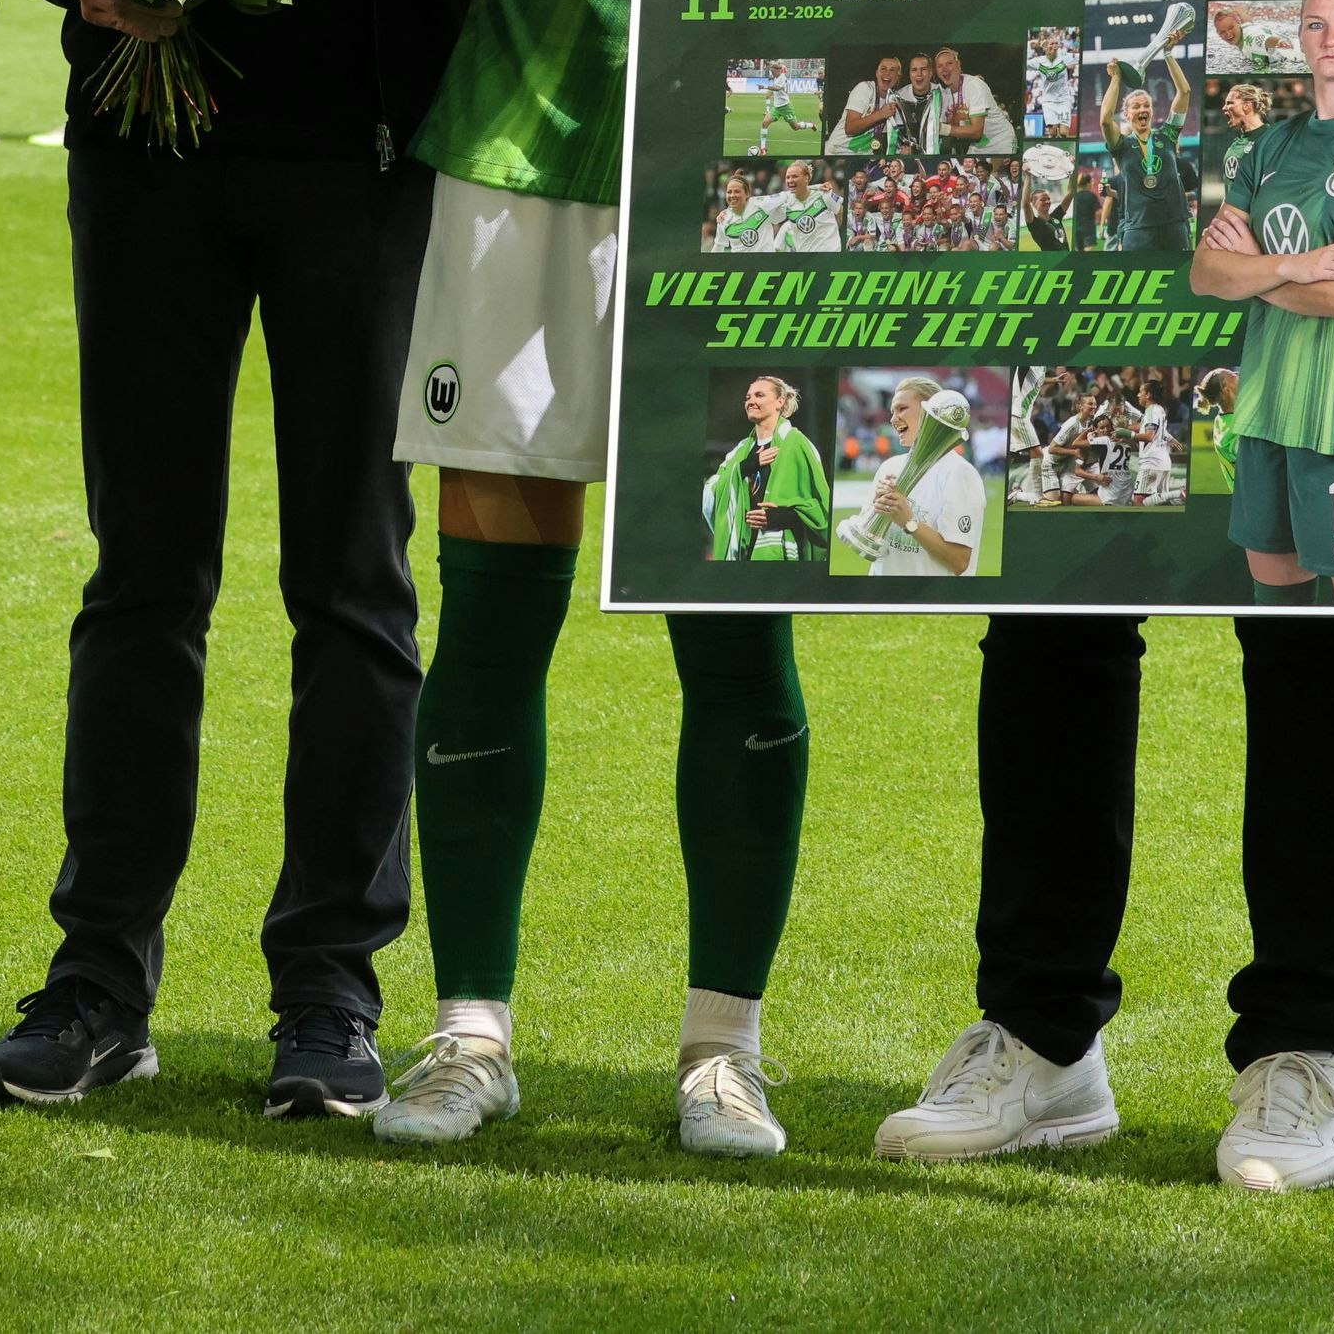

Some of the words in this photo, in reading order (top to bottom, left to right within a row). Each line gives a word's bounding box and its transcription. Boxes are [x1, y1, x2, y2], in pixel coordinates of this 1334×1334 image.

[748, 6, 835, 20] 2012-2026
[645, 271, 817, 306] VIELEN
[817, 270, 966, 306] DANK
[969, 264, 1074, 305] FÜR
[1079, 270, 1176, 305] DIE
[706, 307, 908, 348] SCHÖNE
[911, 312, 1040, 355] ZEIT,
[1057, 312, 1244, 347] POPPI!
[1108, 444, 1132, 471] 28
